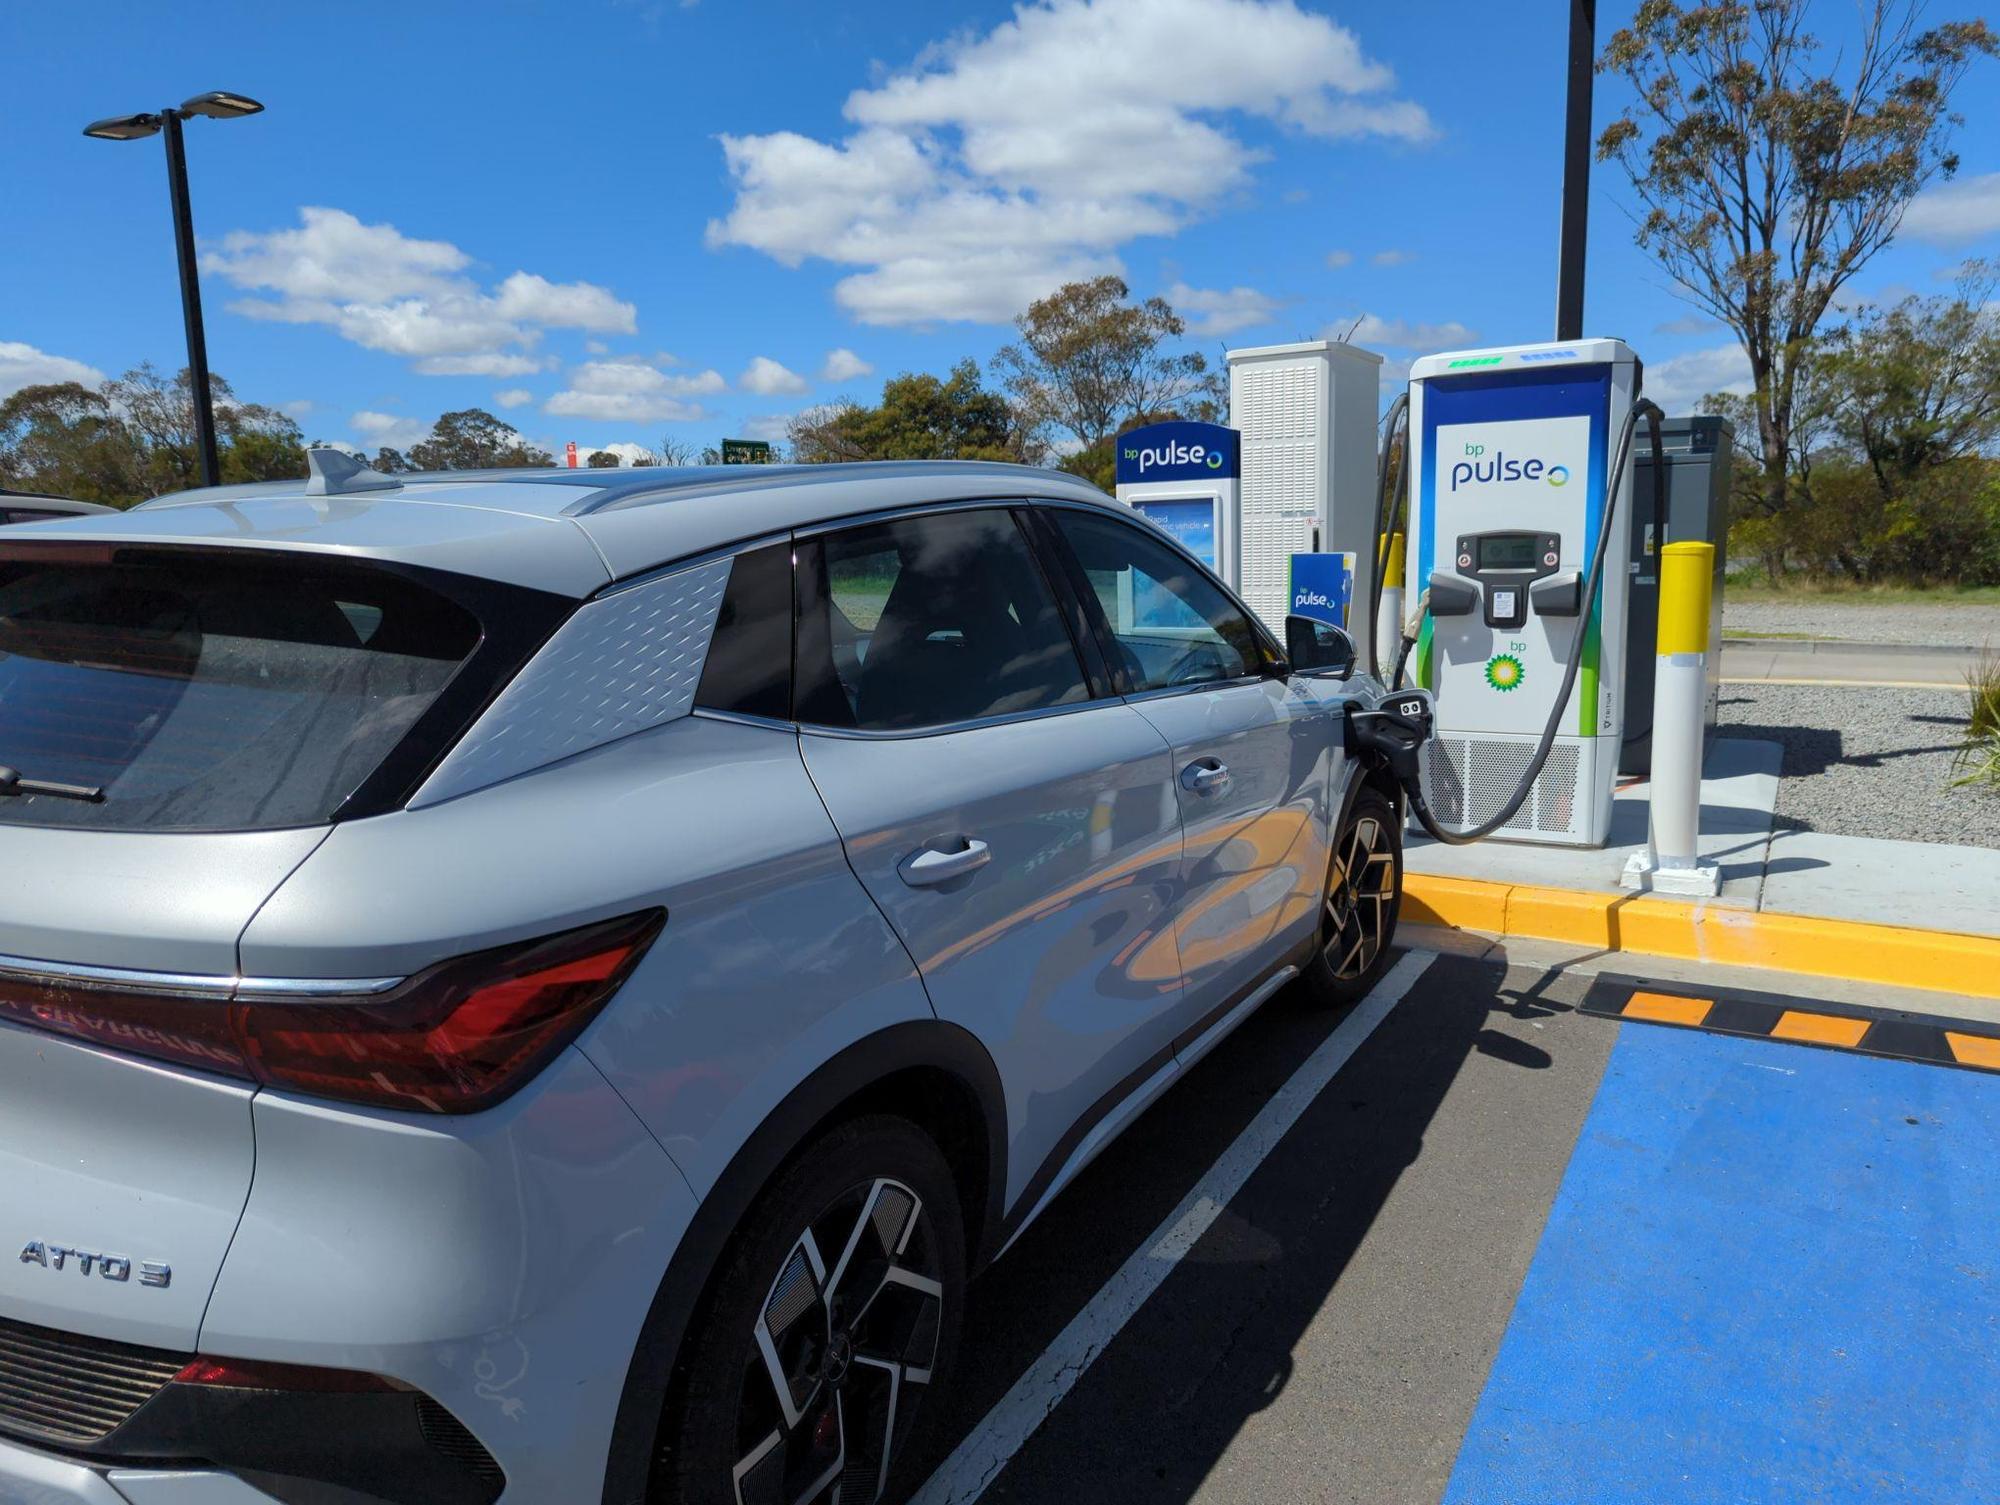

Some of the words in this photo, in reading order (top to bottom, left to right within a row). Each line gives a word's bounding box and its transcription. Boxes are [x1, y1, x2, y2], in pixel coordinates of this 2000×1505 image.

[1124, 447, 1139, 460] bp
[1139, 439, 1205, 474] pulse
[1465, 442, 1485, 458] bp
[1451, 451, 1544, 492] pulse
[1295, 591, 1328, 608] pulse
[1510, 641, 1527, 653] bp
[18, 1240, 131, 1282] ATTO
[138, 1259, 172, 1289] 3
